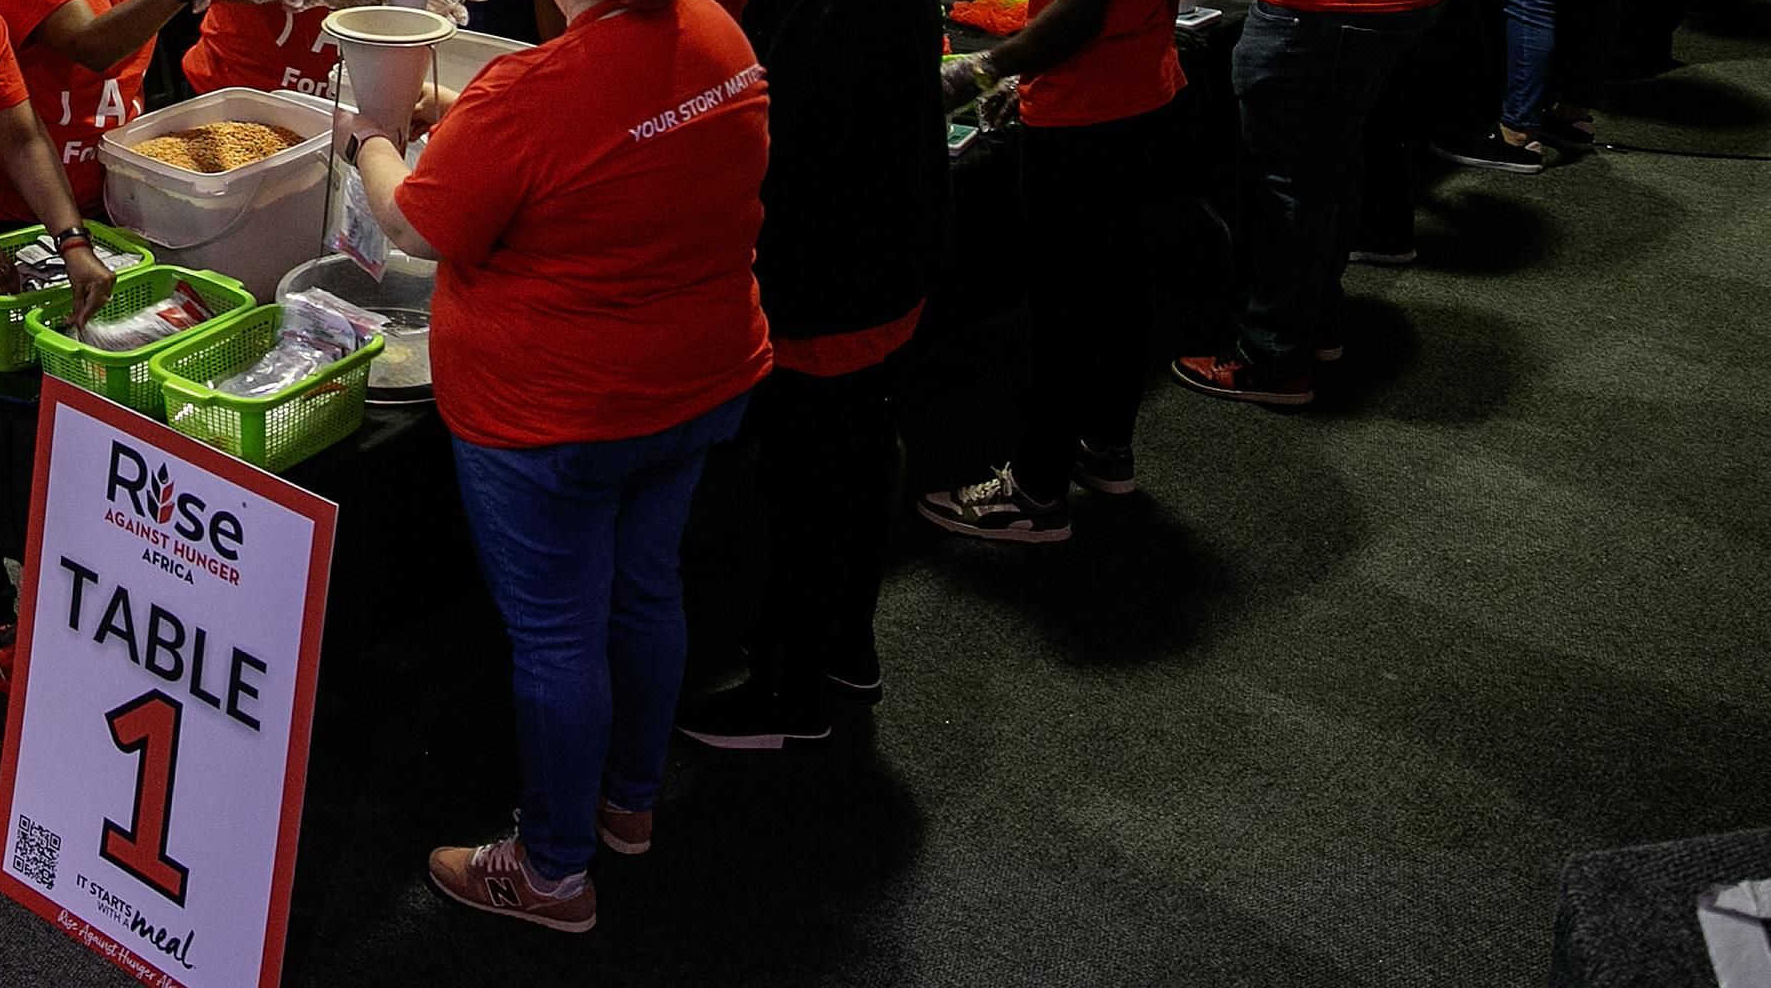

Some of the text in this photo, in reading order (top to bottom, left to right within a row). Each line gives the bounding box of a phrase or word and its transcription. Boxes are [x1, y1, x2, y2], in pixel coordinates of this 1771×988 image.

[629, 110, 679, 142] YOUR
[679, 85, 725, 122] STORY
[106, 439, 244, 561] Rise
[104, 507, 240, 587] AGAINST HUNGER
[142, 548, 195, 585] AFRICA
[60, 555, 268, 733] TABLE
[99, 688, 190, 910] 1
[57, 909, 157, 980] Rise Against Hunger
[76, 873, 195, 970] IT STARTS meal
[97, 901, 130, 930] WITH A
